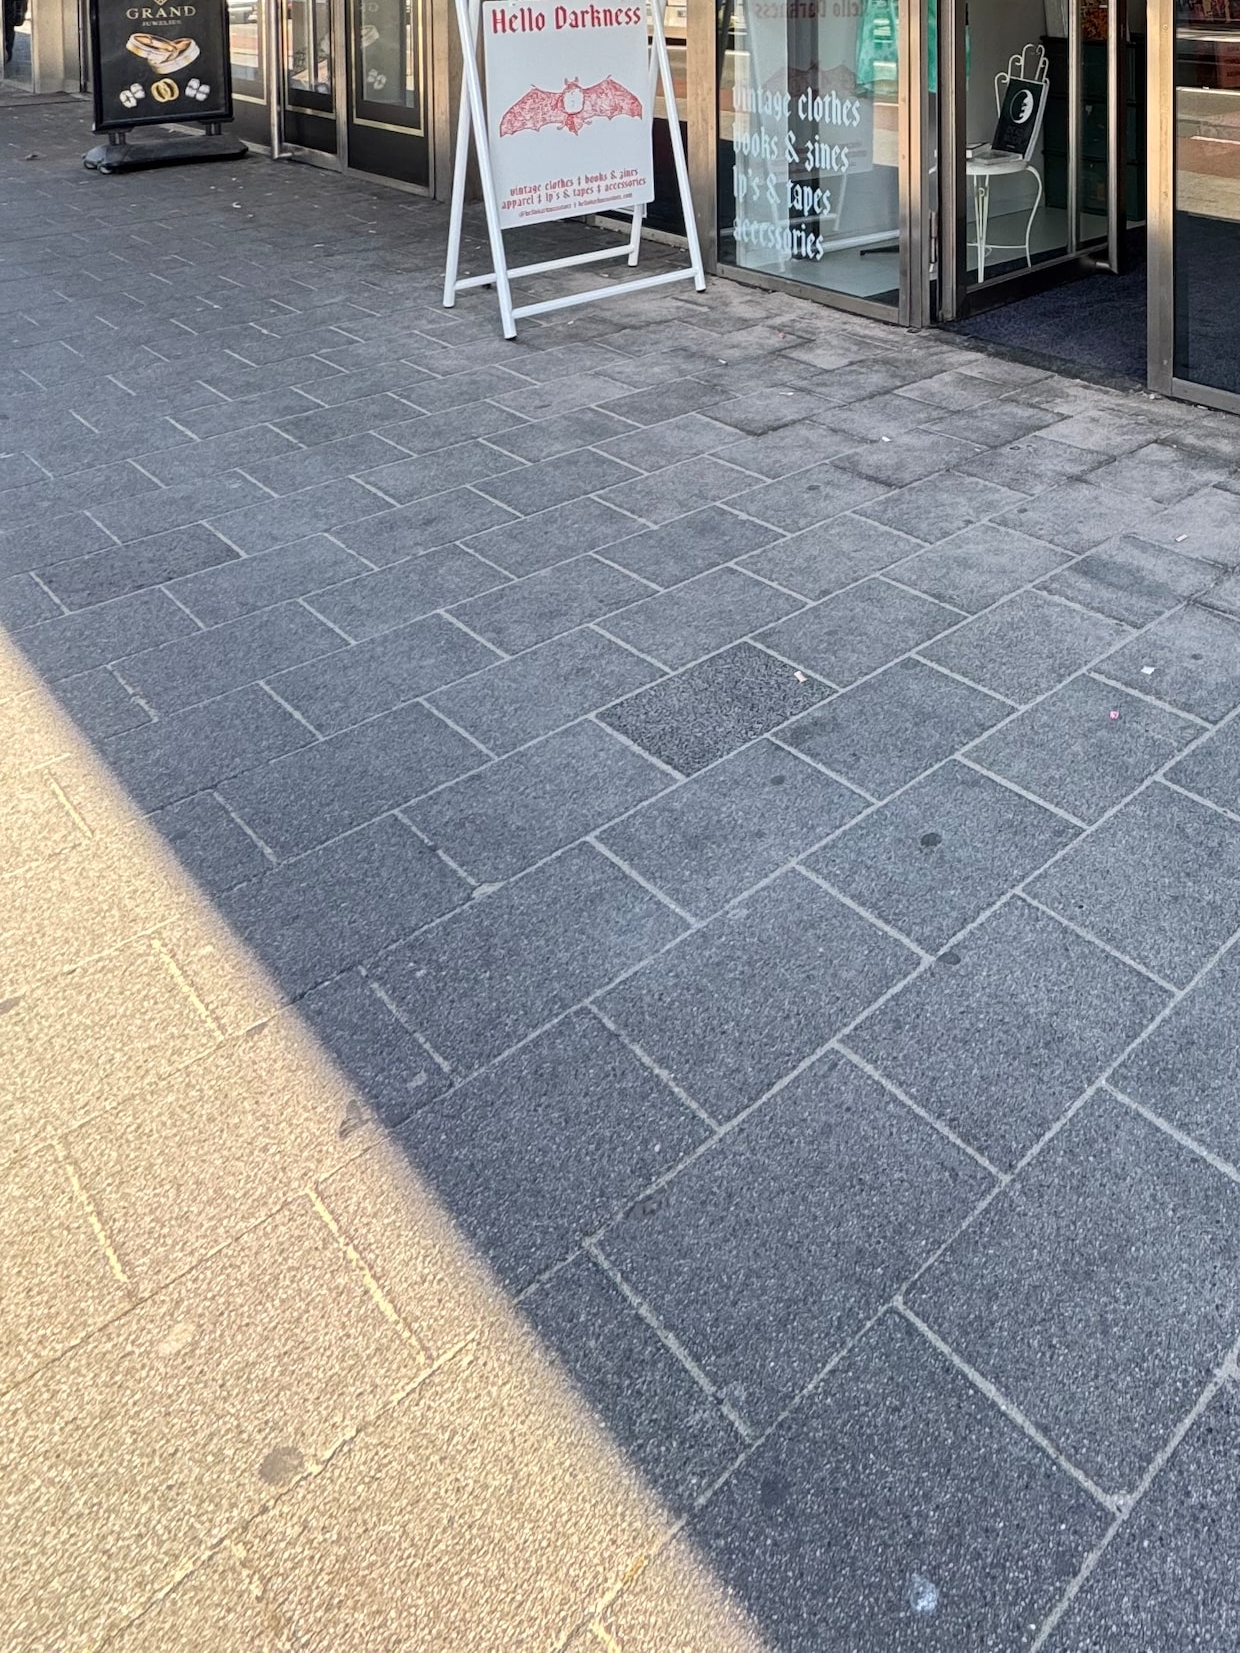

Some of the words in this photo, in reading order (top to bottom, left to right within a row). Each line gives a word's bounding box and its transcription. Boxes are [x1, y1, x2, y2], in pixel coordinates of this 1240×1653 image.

[126, 6, 196, 19] GRAND
[491, 7, 546, 34] Hello
[554, 4, 642, 30] Darkness
[732, 85, 792, 119] vintage
[797, 86, 861, 128] clothes
[732, 122, 779, 162] books
[784, 130, 800, 164] &
[804, 134, 850, 174] zines
[501, 194, 534, 210] apparel
[562, 189, 570, 199] &
[573, 186, 594, 198] tapes
[604, 177, 647, 192] accessories
[509, 182, 542, 197] vintage
[544, 178, 574, 191] clothes
[584, 173, 608, 184] books
[610, 169, 617, 179] &
[619, 167, 639, 179] zines
[732, 165, 761, 203] lp's
[766, 172, 781, 205] &
[787, 178, 832, 217] tapes
[732, 216, 825, 261] accessories
